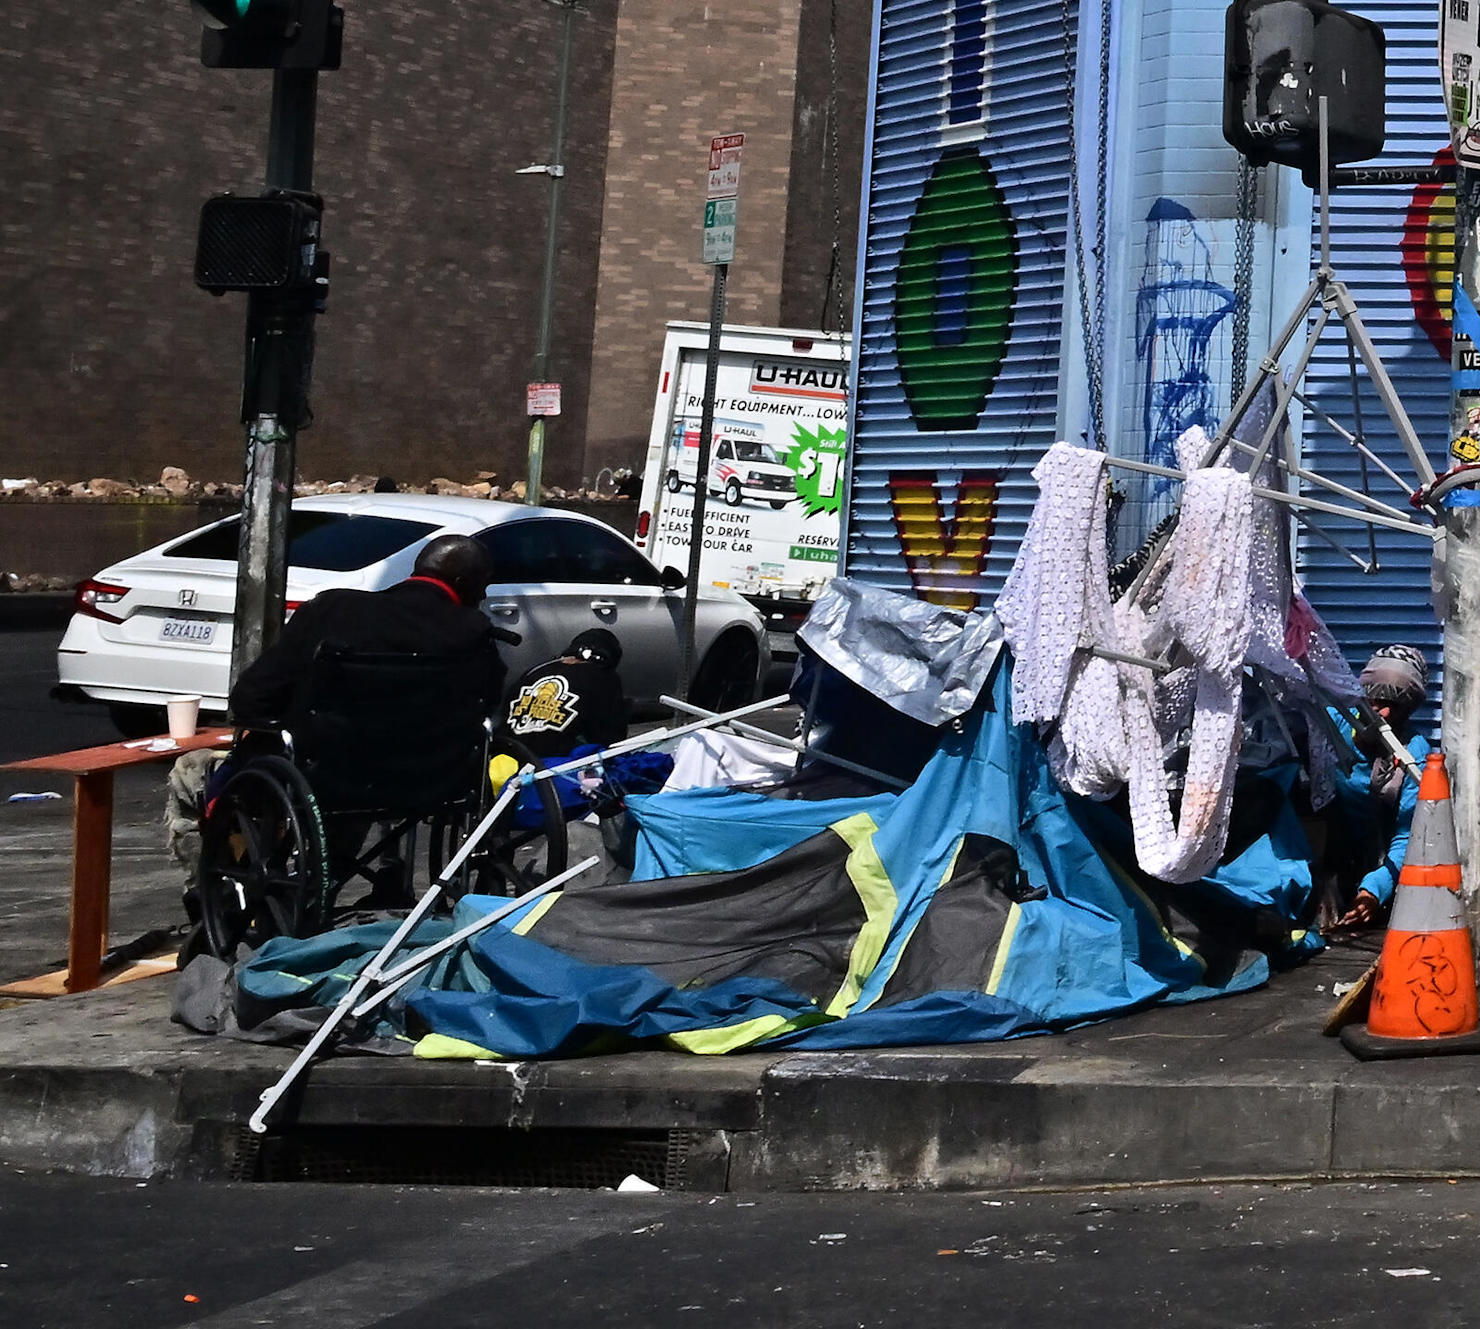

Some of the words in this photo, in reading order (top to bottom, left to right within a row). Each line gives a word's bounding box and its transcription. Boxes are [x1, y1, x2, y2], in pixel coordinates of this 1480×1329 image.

[688, 396, 727, 409] RIHT
[704, 511, 751, 524] FFICIENT
[668, 521, 693, 533] EAS
[718, 526, 750, 539] DRIVE
[703, 539, 728, 551] OUR
[731, 542, 753, 554] CAR
[798, 534, 839, 547] RESERV
[163, 623, 212, 640] 8ZXA118
